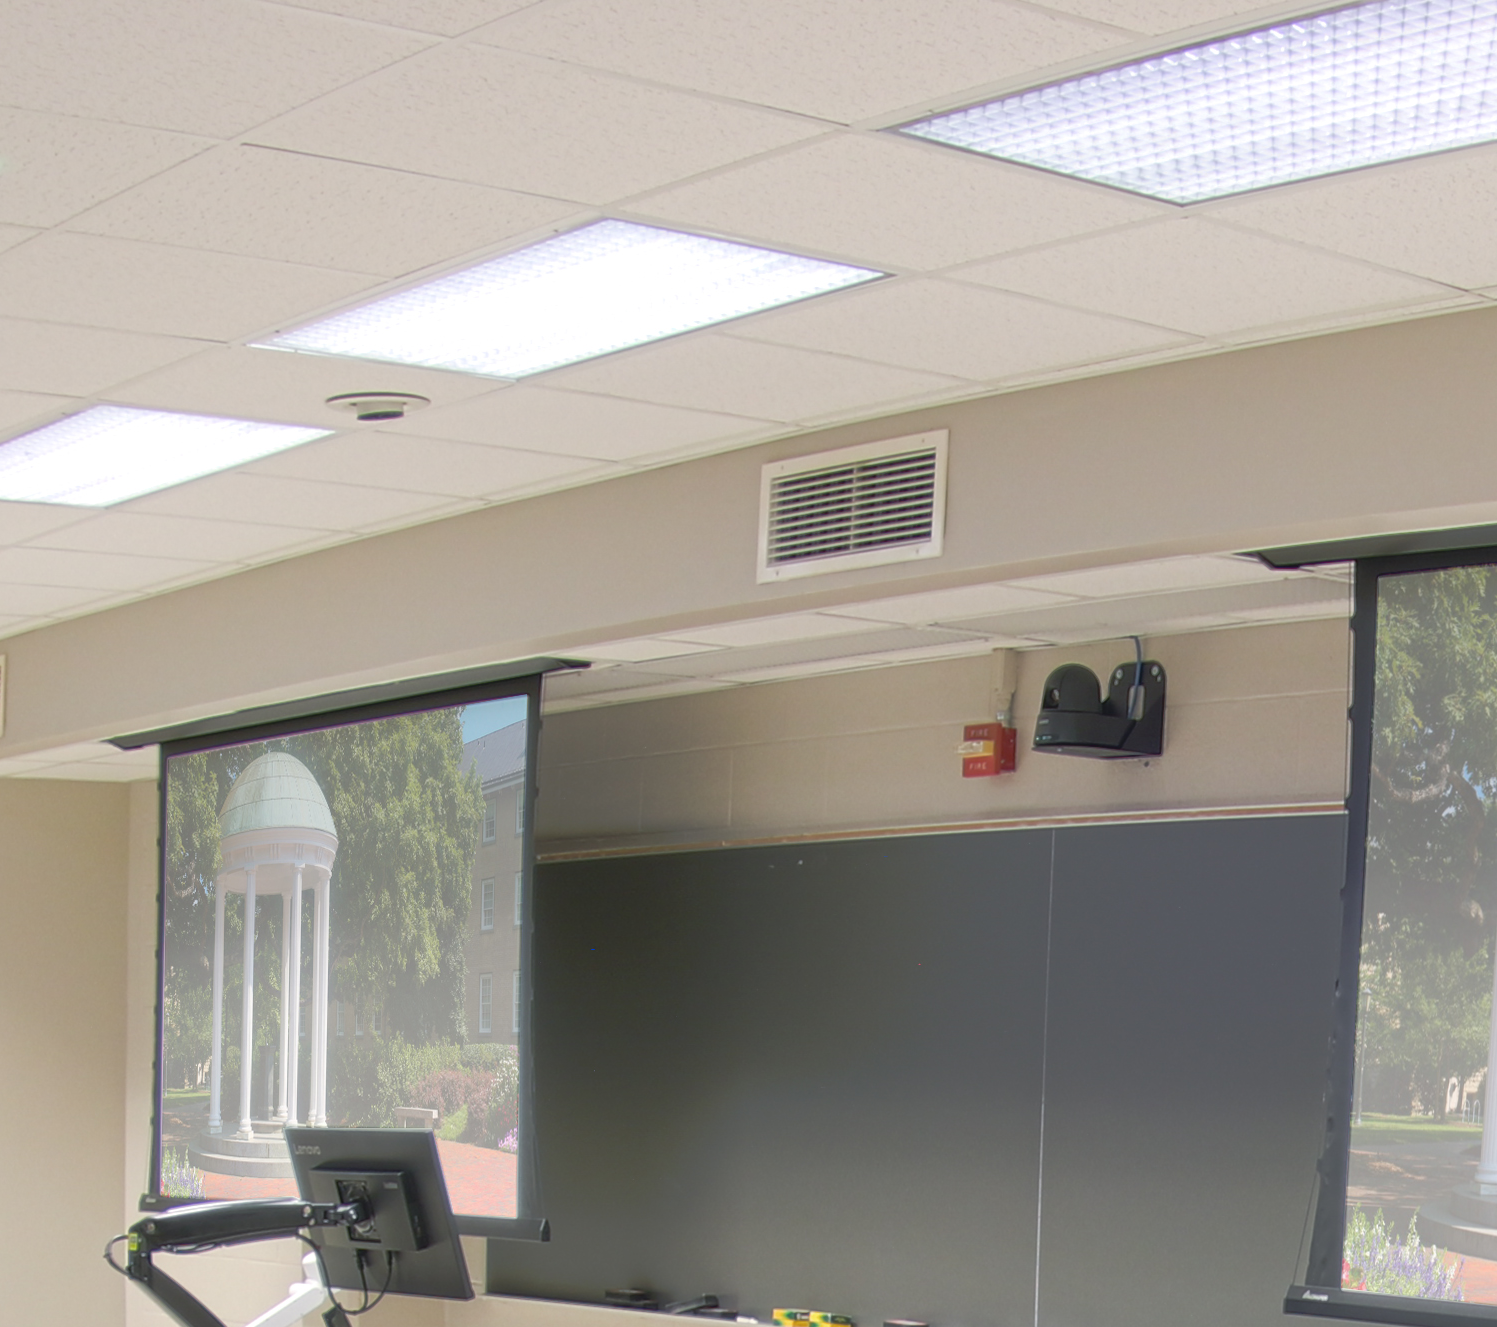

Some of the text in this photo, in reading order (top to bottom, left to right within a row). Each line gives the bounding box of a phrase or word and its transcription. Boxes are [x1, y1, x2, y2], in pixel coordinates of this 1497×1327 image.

[970, 728, 989, 737] FIRE
[969, 762, 988, 770] FIRE
[293, 1143, 321, 1155] Lenovo
